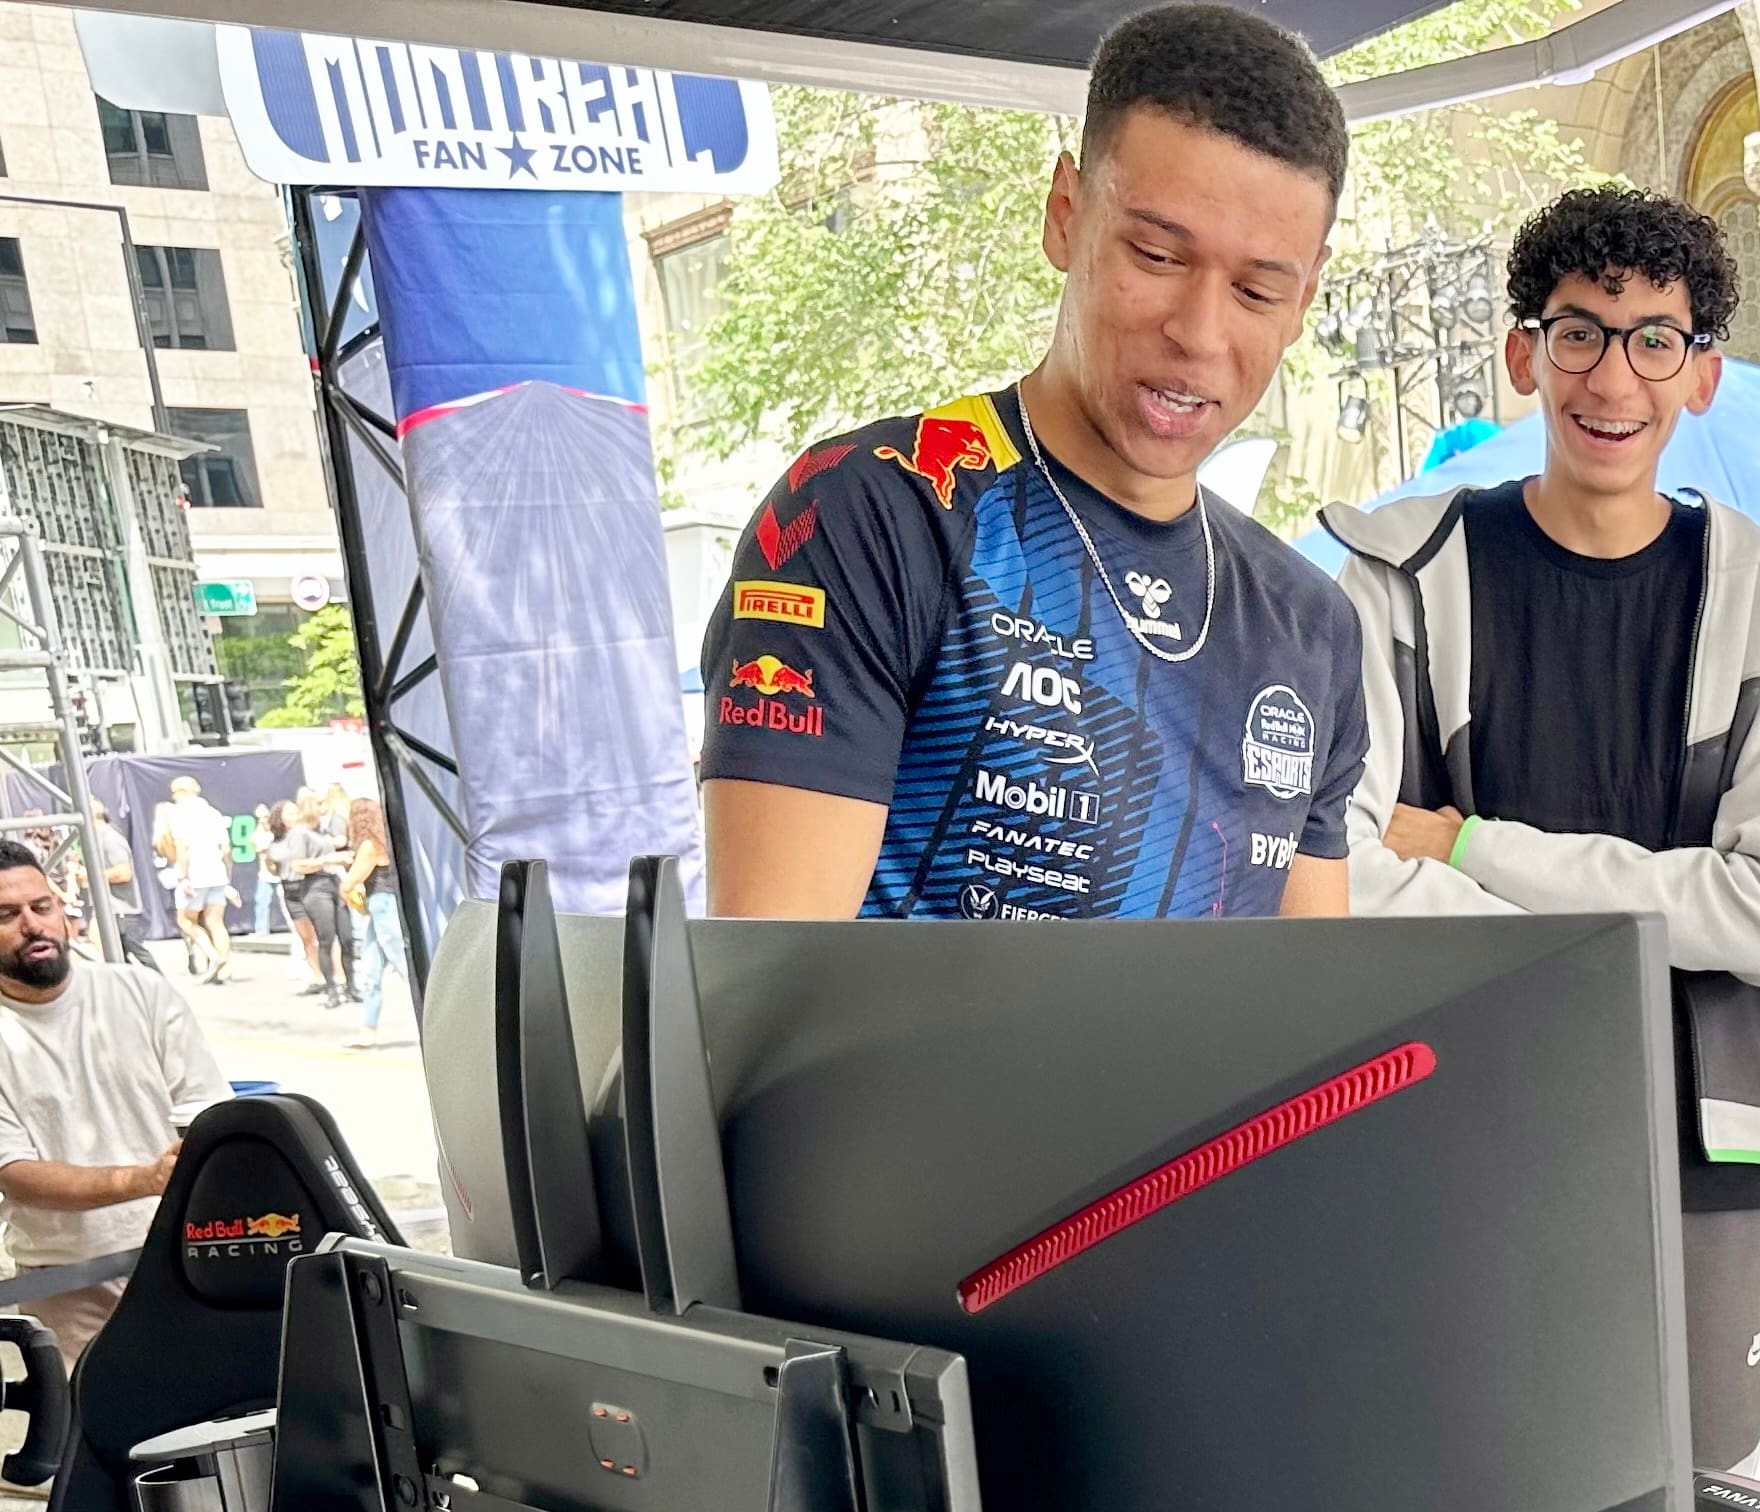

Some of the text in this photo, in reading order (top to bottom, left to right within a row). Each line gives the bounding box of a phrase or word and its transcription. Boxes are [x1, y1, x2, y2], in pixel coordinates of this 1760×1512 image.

[413, 139, 643, 175] FAN ZONE
[739, 589, 815, 619] PIRELLI
[991, 612, 1094, 660] ORACLE
[1001, 661, 1082, 715] AOC
[719, 696, 824, 736] Red Bull
[975, 769, 1067, 818] Mobil
[971, 820, 1094, 860] FANATEC
[1001, 903, 1070, 921] FIERC
[186, 1219, 244, 1241] Red Bull
[187, 1240, 302, 1259] RACING
